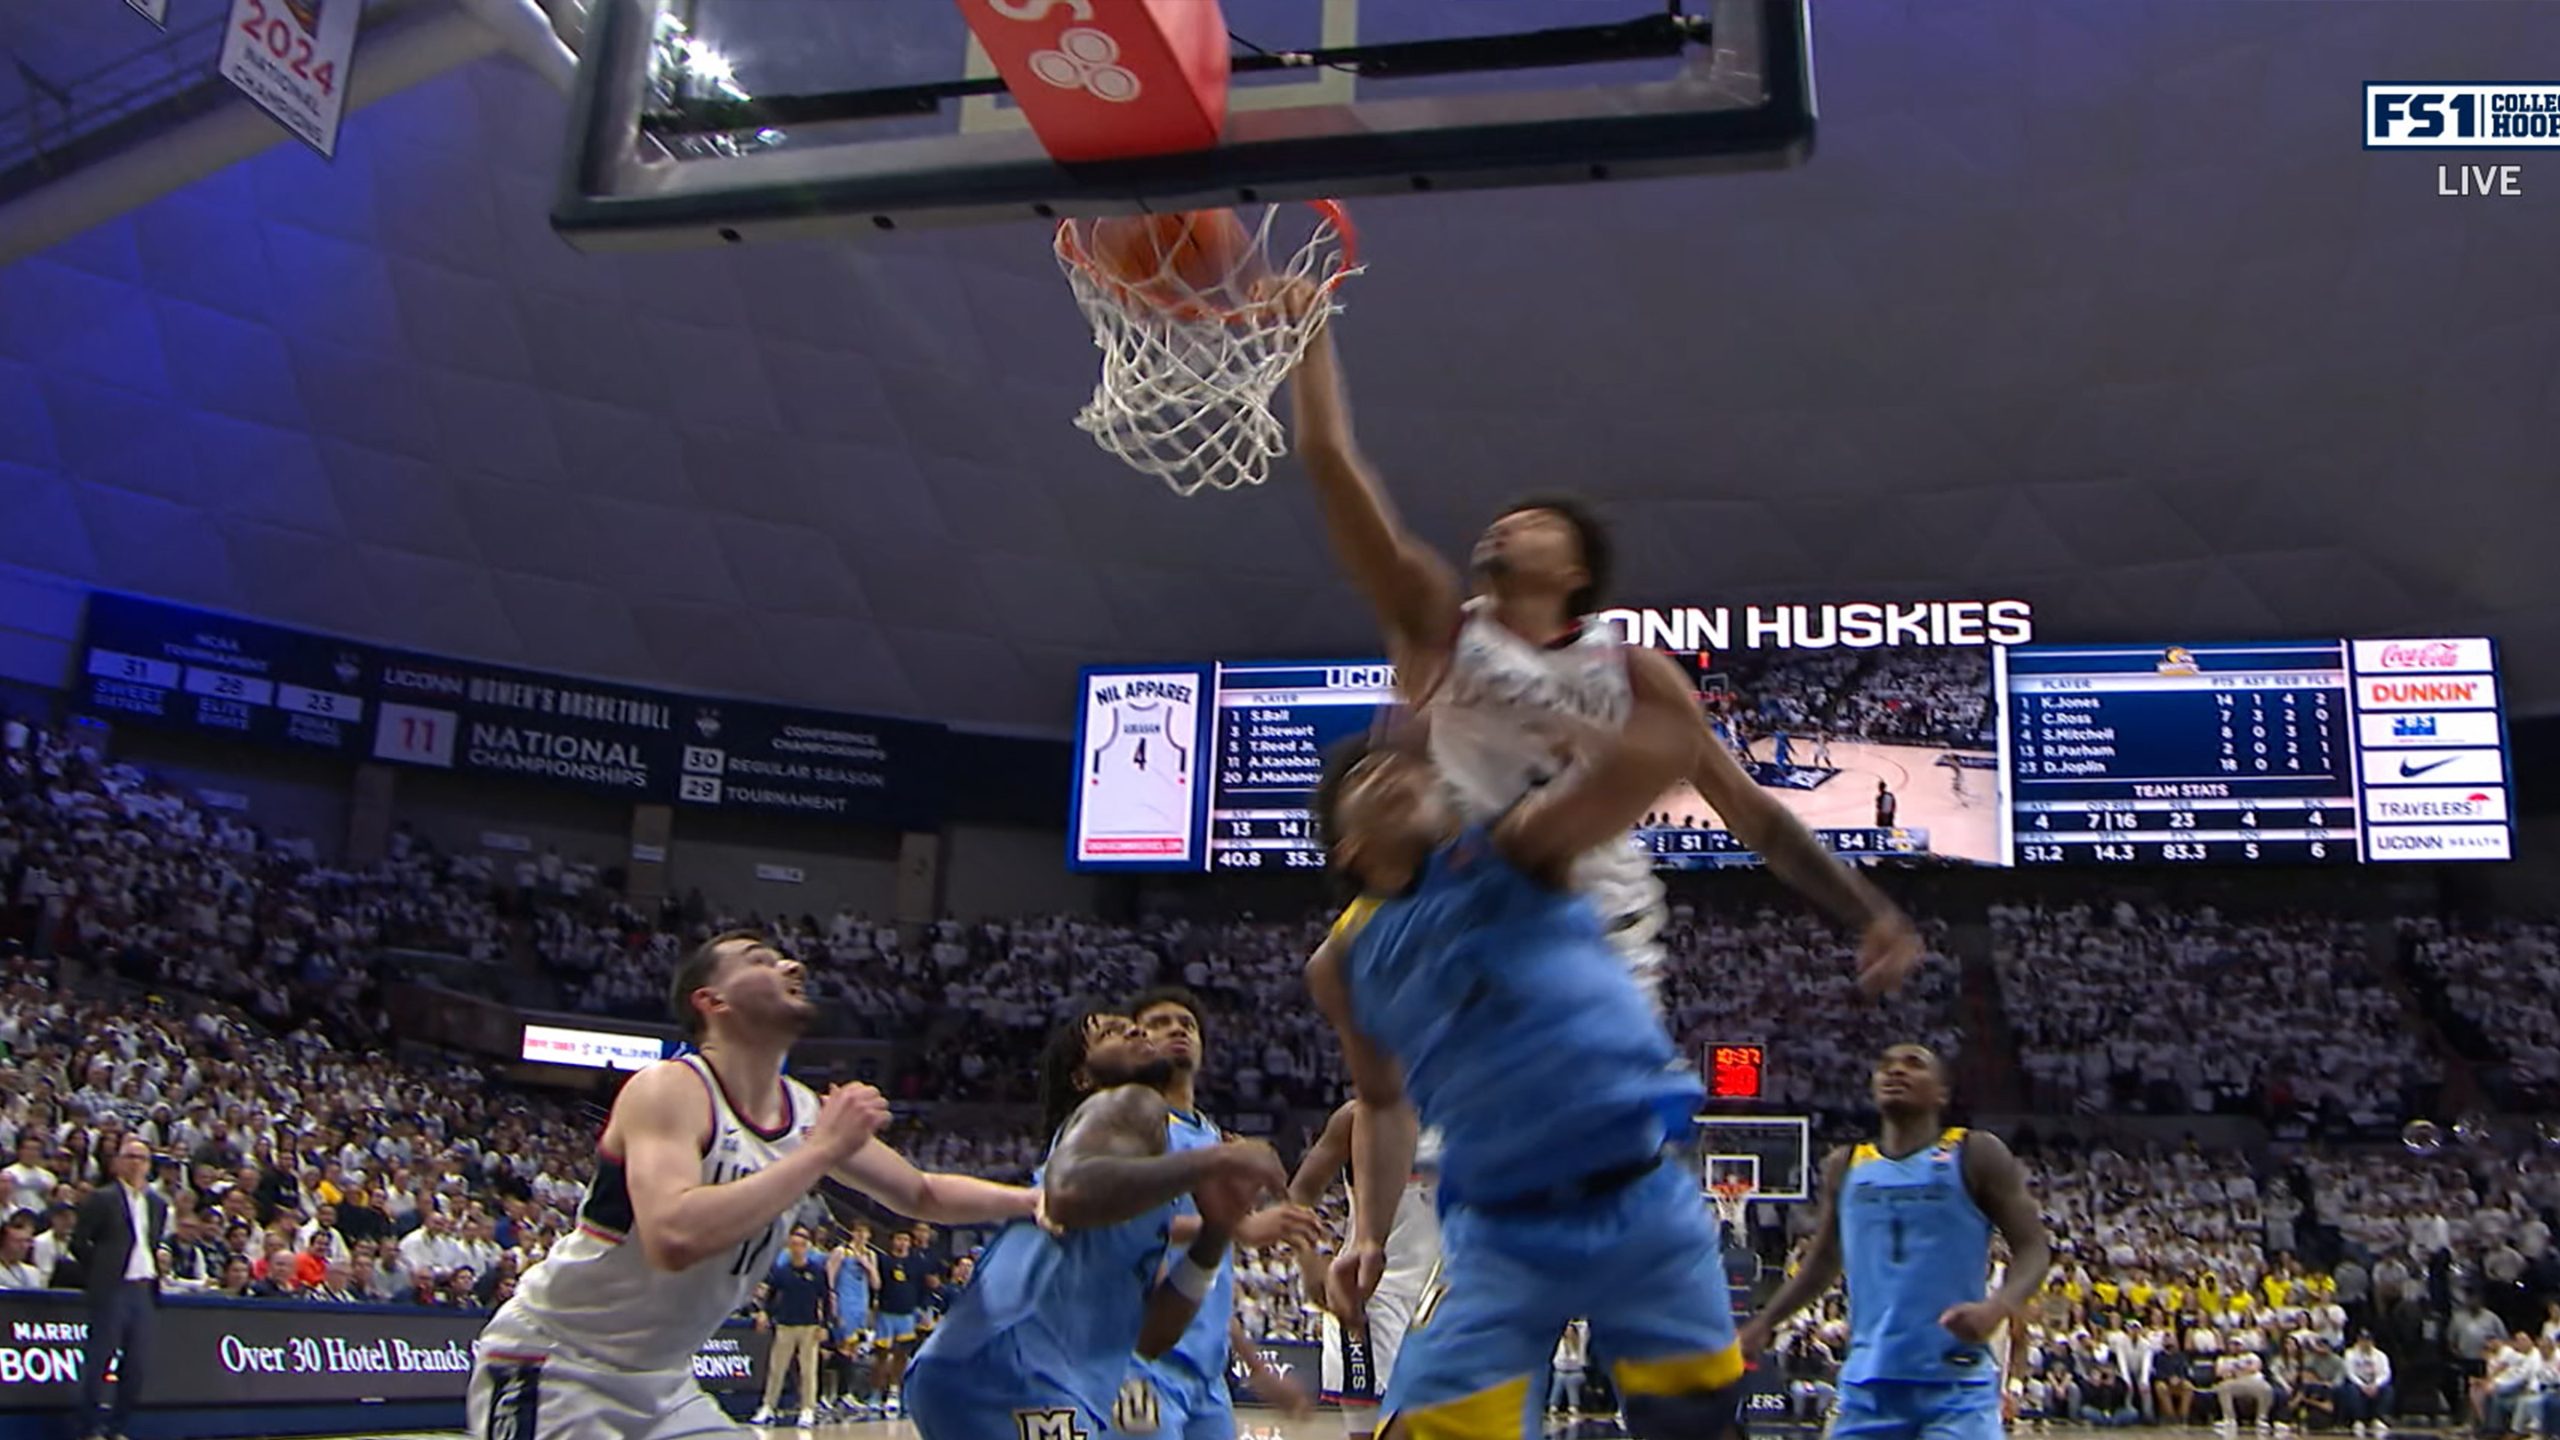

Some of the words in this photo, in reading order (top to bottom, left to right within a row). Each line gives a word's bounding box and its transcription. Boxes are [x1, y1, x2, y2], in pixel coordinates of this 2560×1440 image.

[240, 0, 336, 97] 2024
[1746, 600, 2032, 650] HUSKIES
[120, 658, 148, 678] 31
[2041, 678, 2092, 689] PLAYER
[383, 667, 464, 694] UCONN
[468, 676, 554, 713] WOMEN'S
[558, 690, 671, 730] BASKETBALL
[1096, 684, 1122, 706] NIL
[1125, 681, 1193, 705] APPAREL
[2215, 693, 2234, 706] 14
[2252, 693, 2262, 706] 1
[2282, 692, 2295, 705] 4
[2314, 692, 2327, 705] 2
[306, 692, 335, 713] 23
[2021, 697, 2030, 709] 1
[2041, 697, 2100, 709] K.Jones
[1232, 711, 1241, 722] 1
[1250, 709, 1290, 722] S.Ball
[2020, 713, 2032, 725] 2
[2041, 713, 2092, 725] C.Ross
[2252, 709, 2264, 722] 3
[2284, 709, 2297, 722] 2
[2315, 708, 2329, 721] 0
[401, 717, 437, 754] 11
[782, 725, 879, 747] CONFERENCE
[1249, 725, 1315, 737] J.Stewart
[2020, 729, 2032, 741] 4
[2042, 728, 2115, 741] S.Mitchell
[2252, 725, 2266, 738] 0
[2285, 725, 2298, 738] 3
[2318, 724, 2328, 737] 1
[471, 721, 649, 769] NATIONAL
[770, 738, 888, 762] CHAMPIONSHIPS
[2043, 744, 2116, 757] R.Parham
[2222, 742, 2234, 755] 2
[2253, 741, 2267, 754] 0
[2286, 741, 2298, 754] 2
[2319, 740, 2330, 753] 1
[690, 750, 719, 769] 30
[1133, 737, 1147, 771] 4
[1248, 755, 1322, 768] A.Karaban
[468, 750, 649, 788] CHAMPIONSHIPS
[2018, 761, 2037, 774] 23
[2043, 760, 2107, 776] D.Joplin
[2254, 758, 2268, 771] 0
[2287, 757, 2300, 770] 4
[2320, 756, 2331, 770] 1
[728, 757, 811, 780] REGULAR
[815, 765, 886, 787] SEASON
[687, 779, 714, 798] 29
[2134, 784, 2178, 798] TEAM
[2180, 783, 2229, 797] STATS
[726, 786, 848, 812] TOURNAMENT
[2378, 802, 2473, 817] TRAVELERS
[2034, 813, 2049, 829] 4
[2169, 812, 2196, 828] 23
[2241, 811, 2256, 828] 4
[2308, 811, 2323, 826] 4
[1230, 821, 1252, 837] 13
[1680, 832, 1702, 849] 51
[1839, 832, 1865, 849] 54
[2377, 836, 2443, 851] UCONN
[2449, 837, 2501, 848] HEALTH
[2024, 845, 2064, 862] 51.2
[2094, 845, 2136, 861] 14.3
[2162, 844, 2207, 860] 83.3
[2245, 843, 2260, 859] 5
[2310, 842, 2325, 859] 6
[1218, 852, 1262, 867] 40.8
[1285, 851, 1327, 867] 35.3
[1890, 1217, 1906, 1265] 1
[218, 1334, 285, 1373] Over
[287, 1336, 322, 1372] 30
[324, 1336, 393, 1373] Hotel
[396, 1338, 471, 1374] Brands
[0, 1346, 84, 1383] BON
[693, 1354, 752, 1377] BONVOY
